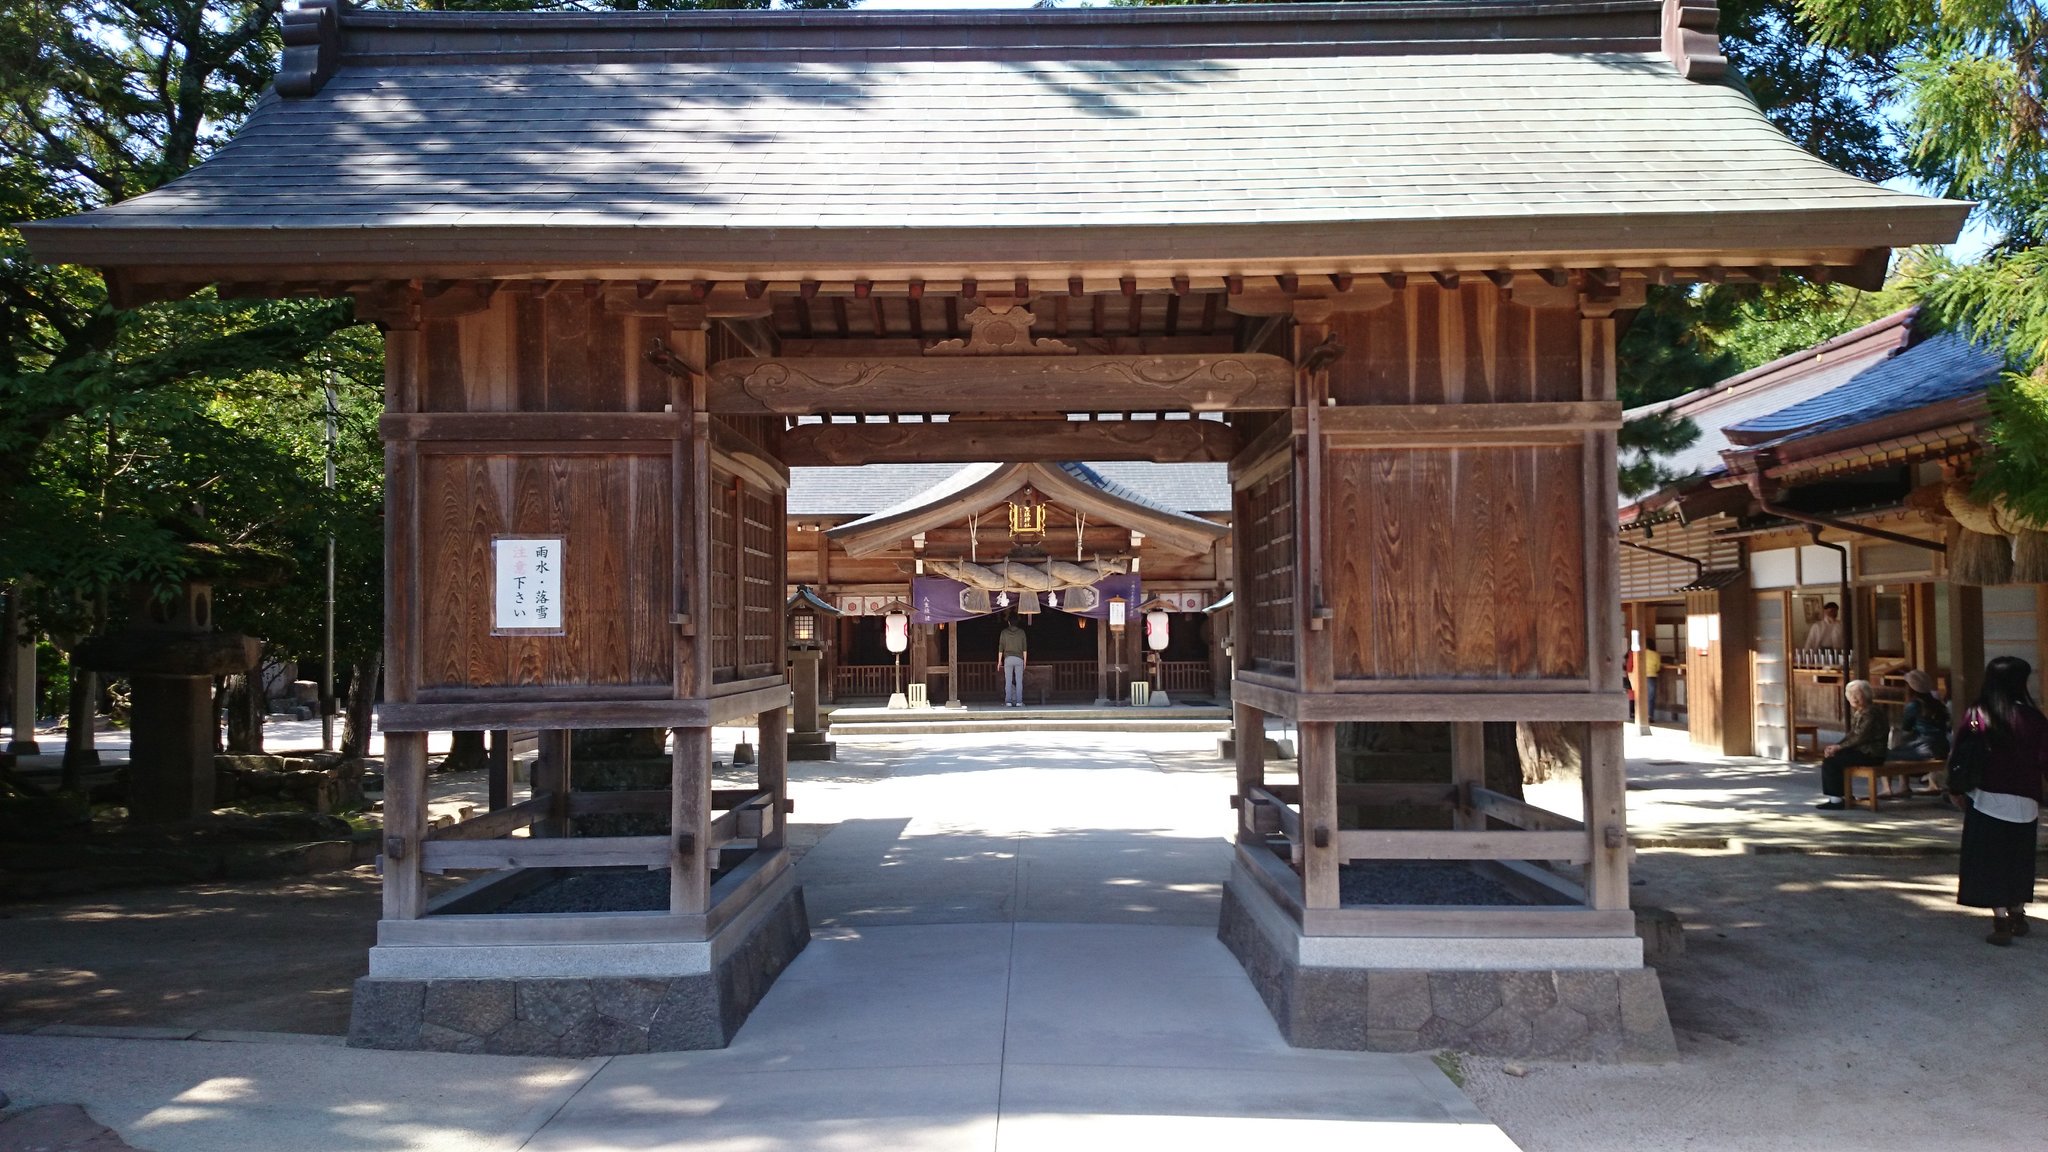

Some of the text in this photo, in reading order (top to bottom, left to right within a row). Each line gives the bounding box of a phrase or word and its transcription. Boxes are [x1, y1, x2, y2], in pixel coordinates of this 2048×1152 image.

[536, 546, 550, 619] 雨水・落雪
